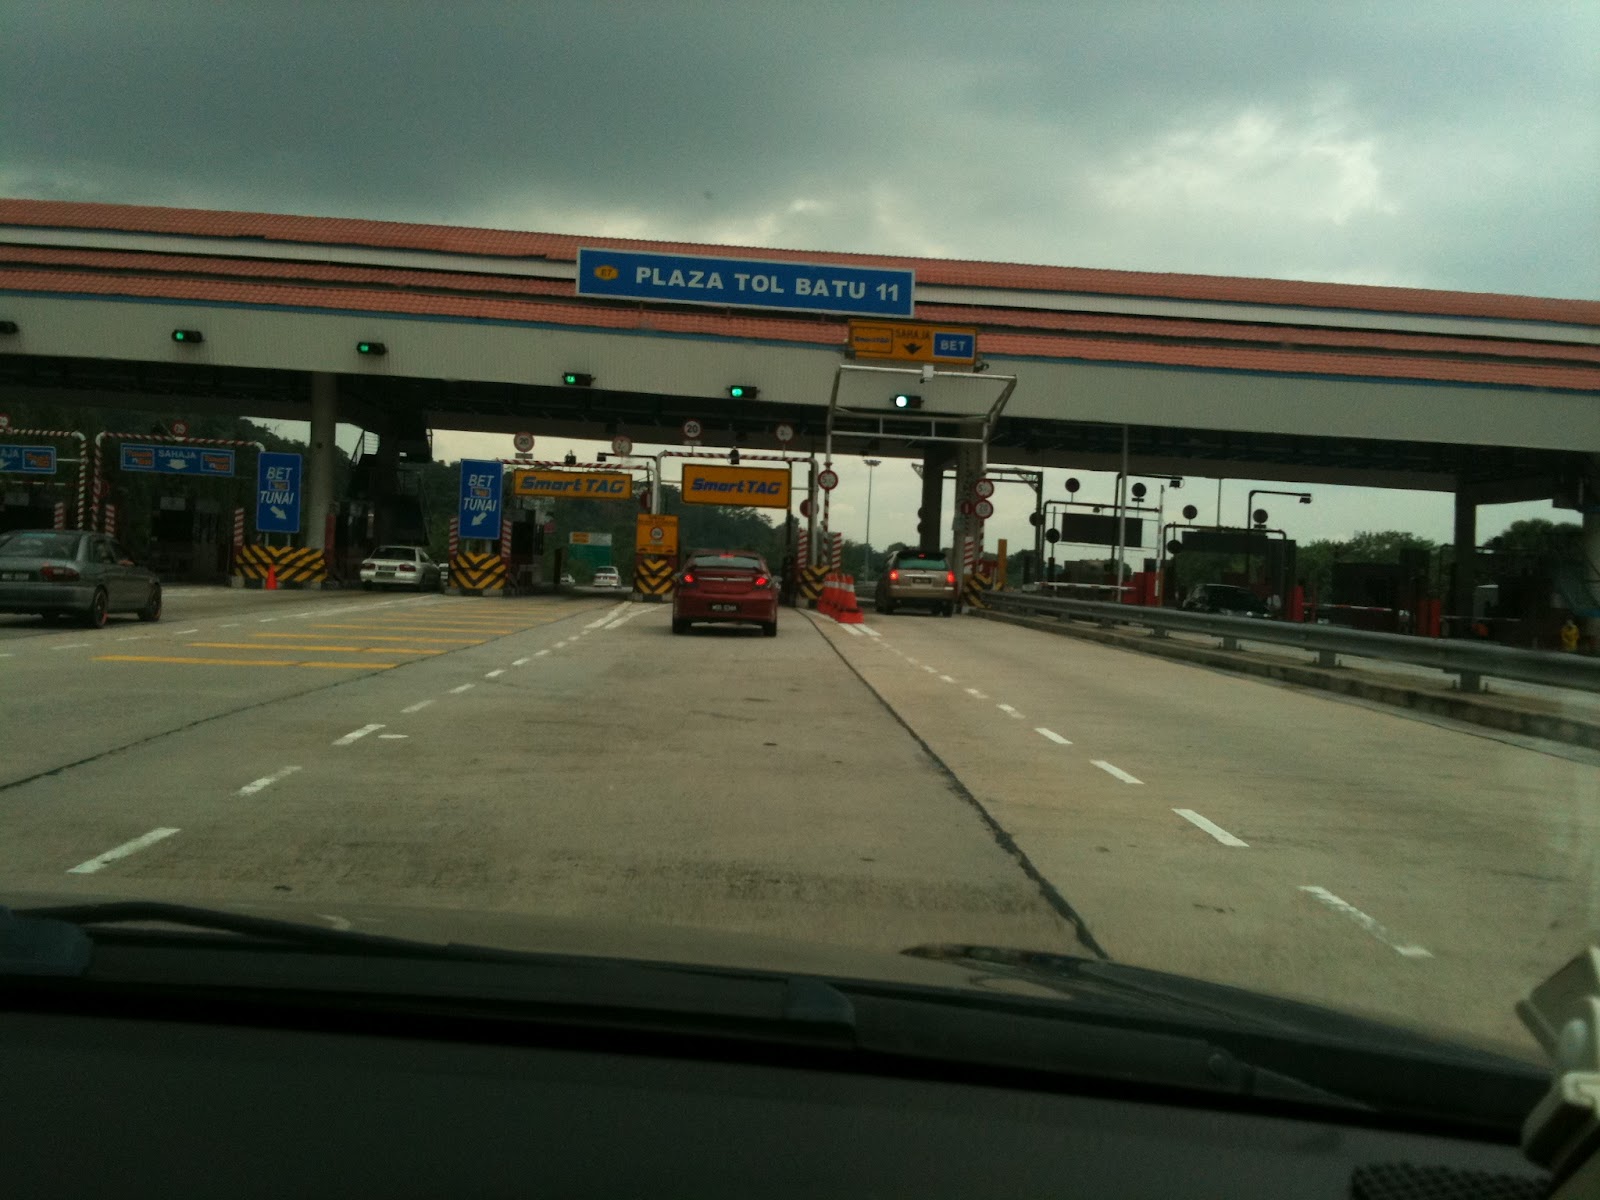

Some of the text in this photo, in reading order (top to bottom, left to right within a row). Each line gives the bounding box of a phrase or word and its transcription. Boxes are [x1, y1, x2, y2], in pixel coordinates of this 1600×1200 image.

[635, 266, 898, 302] PLAZA TOL BATU 11
[940, 339, 966, 352] BET
[686, 424, 698, 433] 20
[518, 437, 529, 445] 20
[158, 449, 197, 459] SAHAJA
[266, 466, 293, 480] BET
[467, 474, 495, 487] BET
[260, 490, 294, 505] TUNAI
[463, 497, 497, 512] TUNAI
